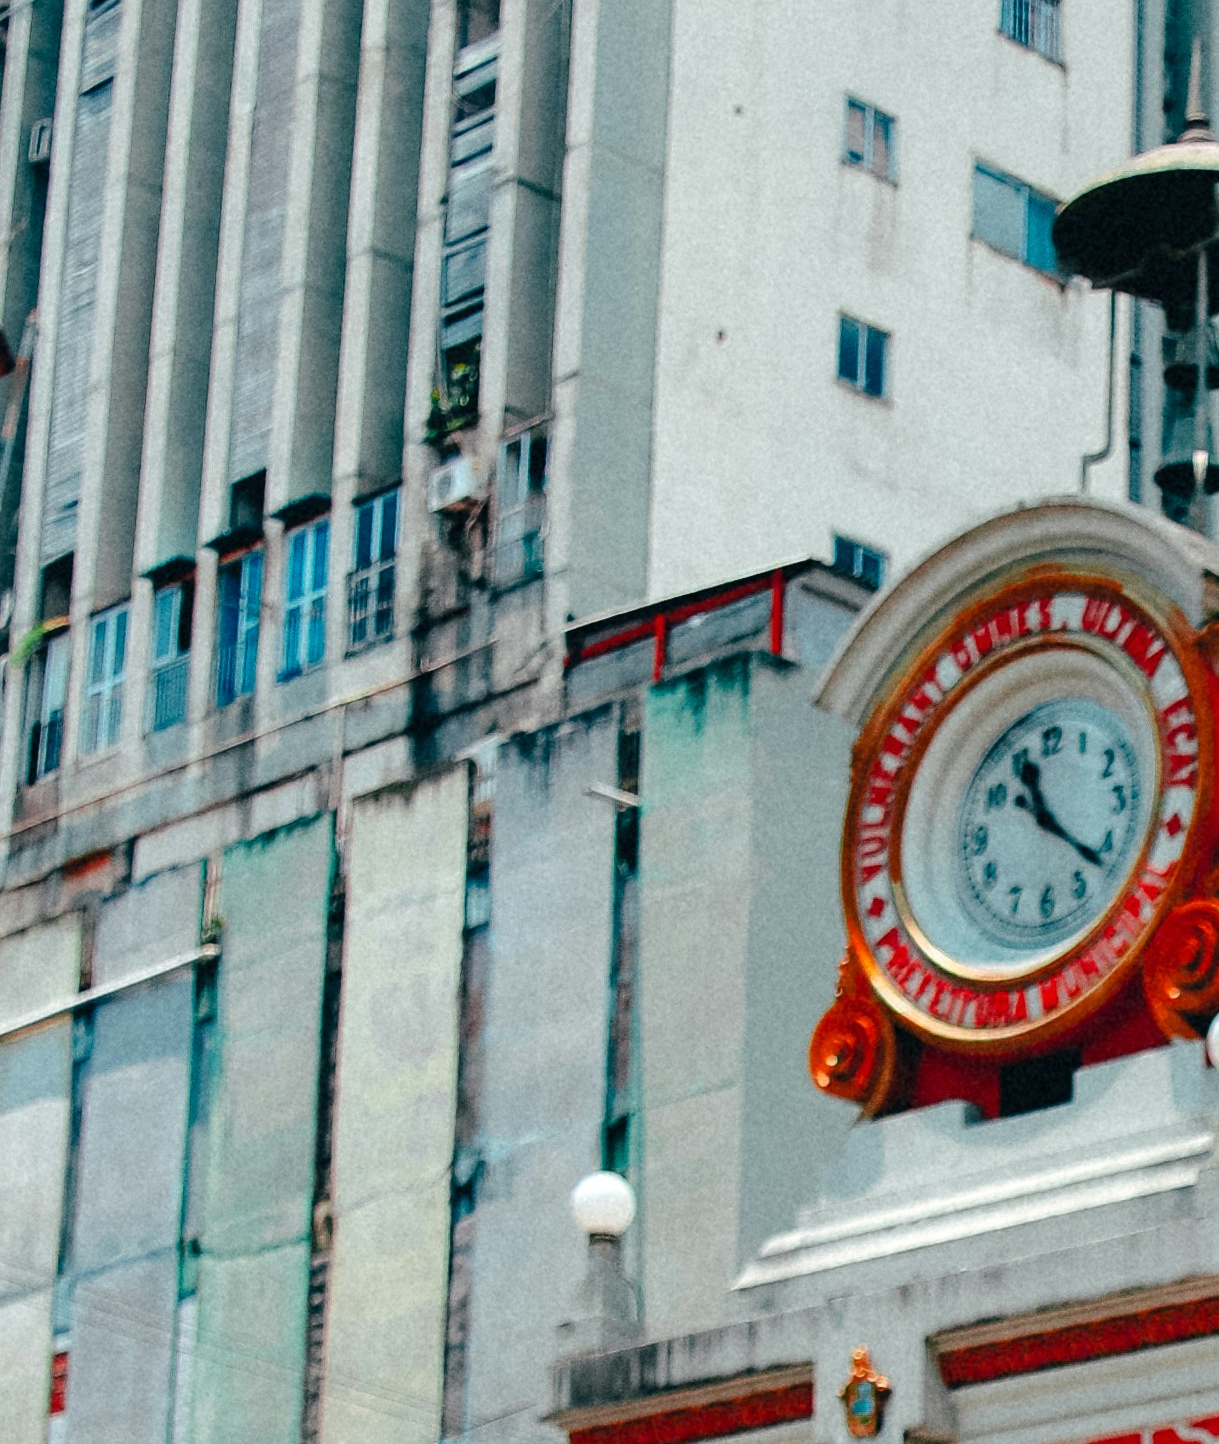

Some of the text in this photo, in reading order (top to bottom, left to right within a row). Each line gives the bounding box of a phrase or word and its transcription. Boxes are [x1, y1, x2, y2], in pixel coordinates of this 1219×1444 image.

[1079, 731, 1087, 754] 1
[1103, 748, 1115, 779] 2
[1112, 784, 1126, 815] 3
[1009, 885, 1022, 915] 7
[1073, 870, 1086, 900] 5
[1040, 884, 1055, 918] 6
